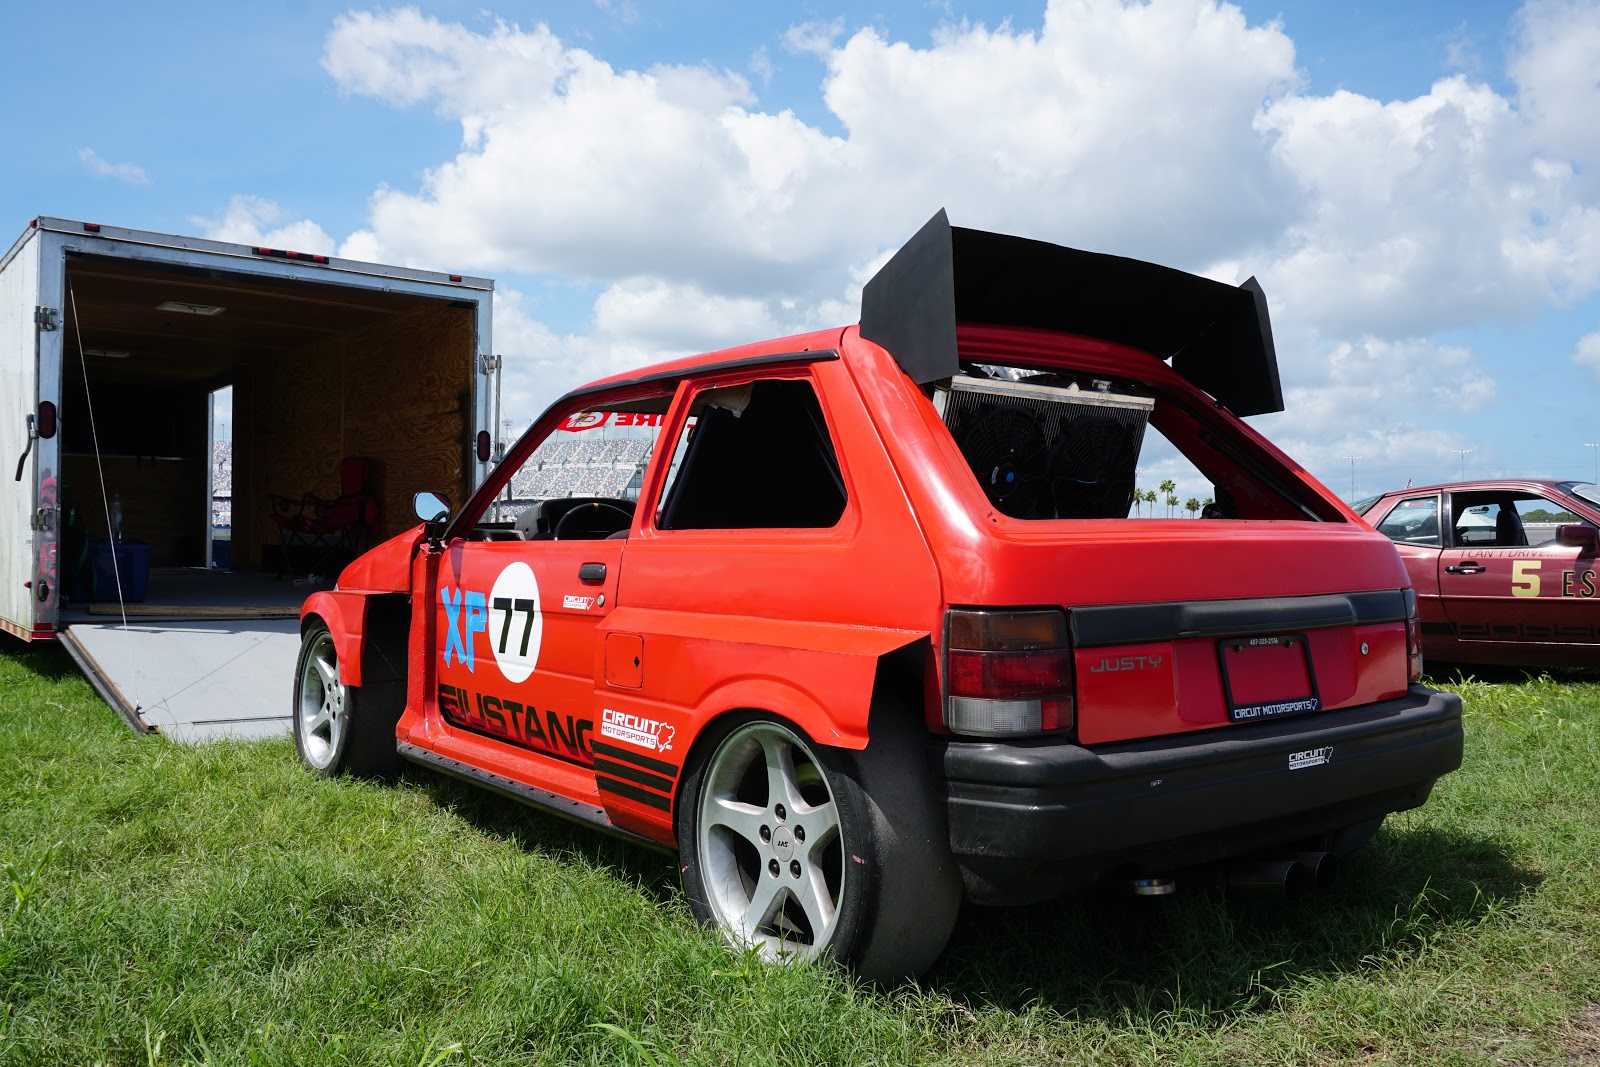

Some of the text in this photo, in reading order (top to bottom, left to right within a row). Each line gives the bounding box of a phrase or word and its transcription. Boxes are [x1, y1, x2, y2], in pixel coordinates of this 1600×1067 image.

[1512, 560, 1597, 598] 5 ES
[564, 595, 588, 603] CIRCUIT
[440, 586, 487, 674] XP
[493, 598, 535, 657] 77
[1090, 655, 1162, 673] JUSTY
[1234, 700, 1312, 719] CIRCUIT MOTORSPORTS
[602, 708, 660, 735] CIRCUIT
[602, 725, 656, 746] MOTORSPORTS
[1289, 747, 1325, 762] CIRCUIT
